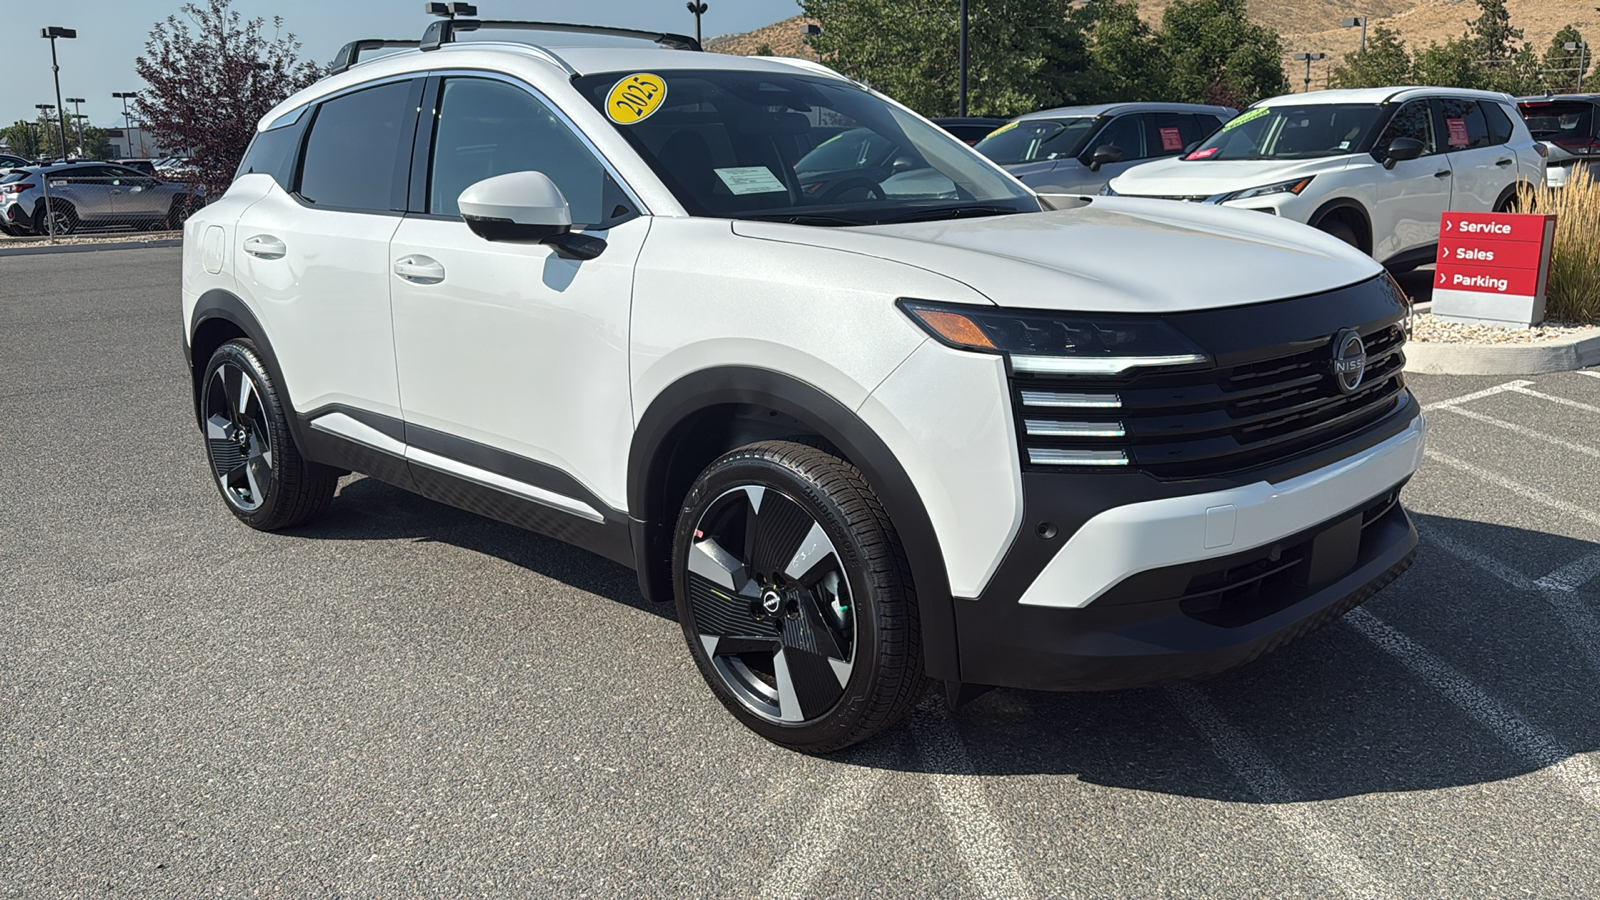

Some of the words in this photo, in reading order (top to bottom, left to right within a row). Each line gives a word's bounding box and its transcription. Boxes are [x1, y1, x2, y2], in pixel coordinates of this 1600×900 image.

[616, 76, 658, 117] 2025
[1459, 221, 1511, 234] Service
[1456, 247, 1494, 260] Sales
[1453, 274, 1508, 291] Parking
[1336, 359, 1365, 372] NISS
[803, 486, 861, 568] BRIDGESTONE
